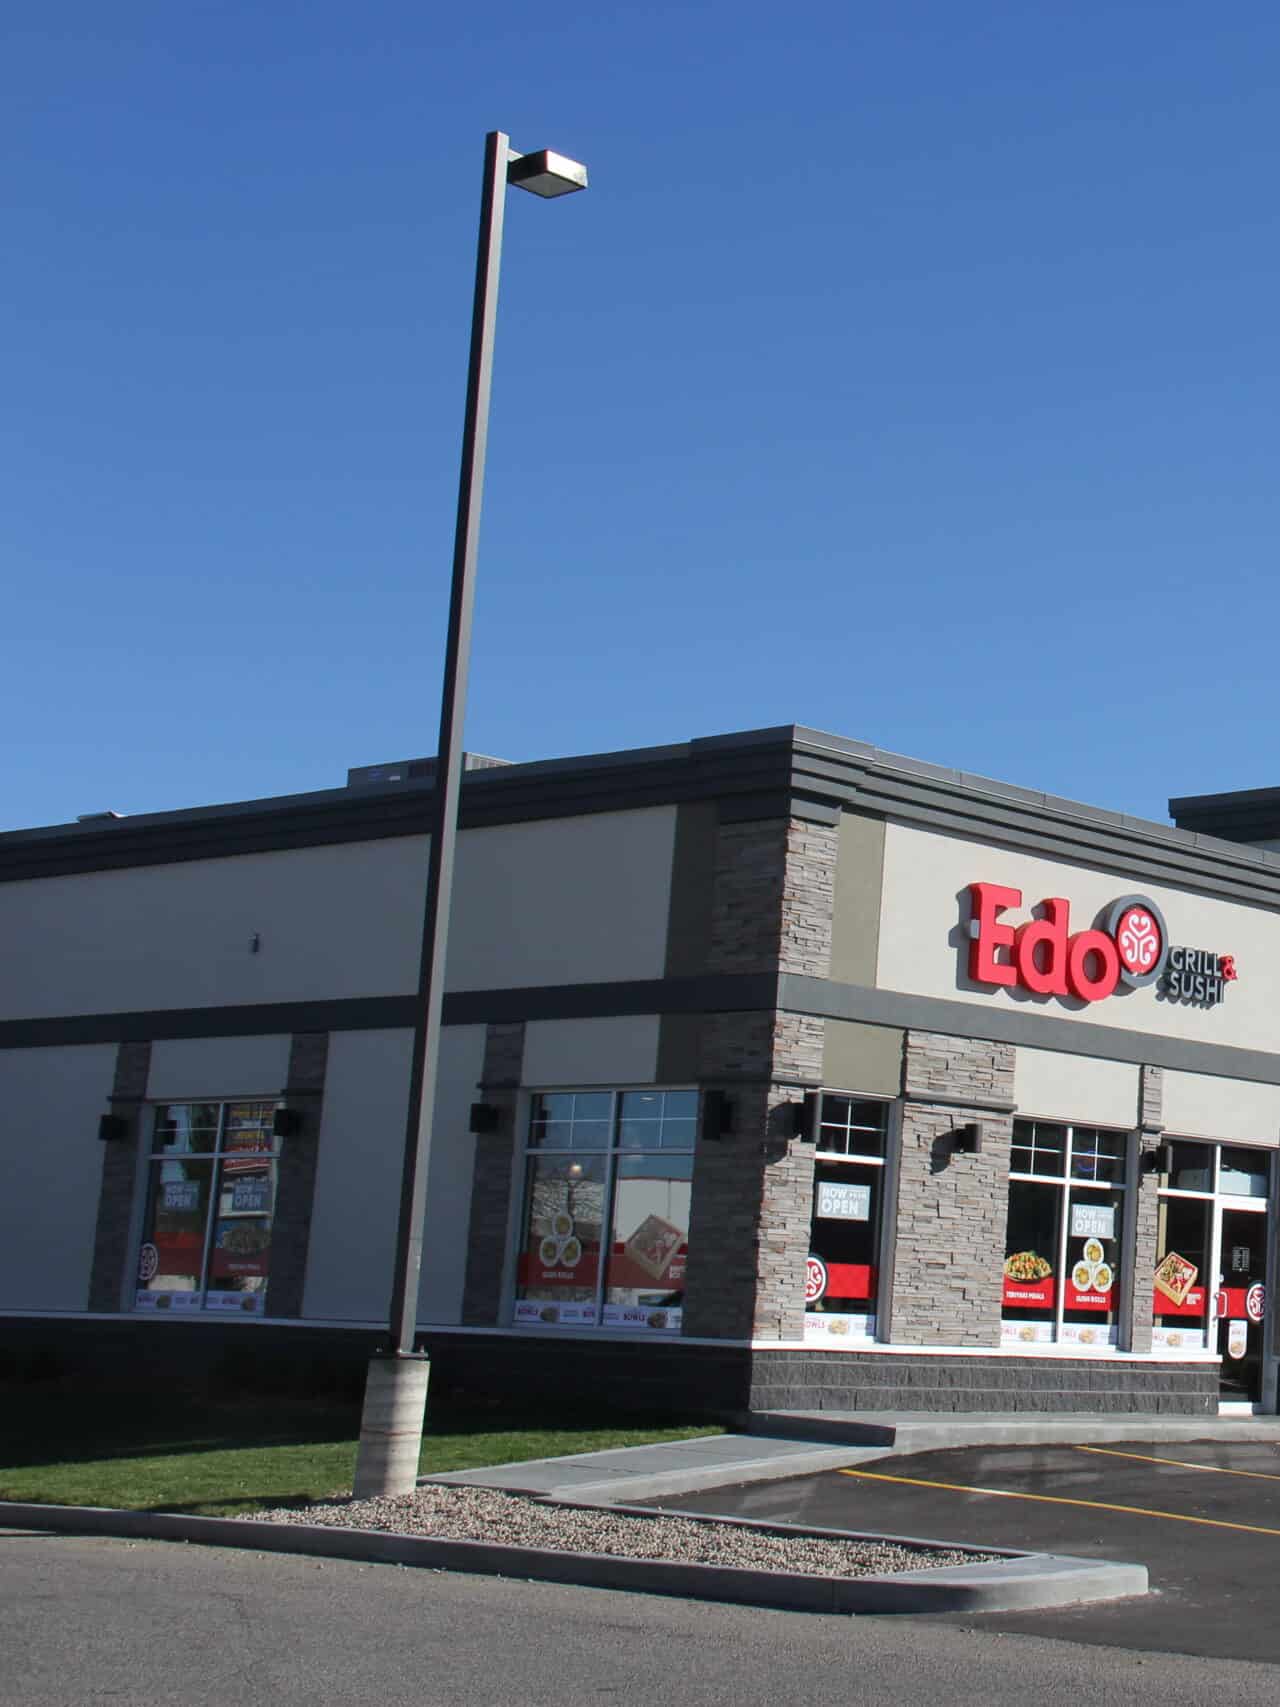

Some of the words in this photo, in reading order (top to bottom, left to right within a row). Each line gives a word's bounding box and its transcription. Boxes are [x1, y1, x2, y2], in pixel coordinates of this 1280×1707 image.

[969, 882, 1120, 1002] Edo
[1170, 946, 1222, 977] GRILL
[1169, 971, 1225, 1003] SUSHI
[235, 1193, 262, 1208] OPEN
[822, 1199, 858, 1215] OPEN
[1075, 1220, 1106, 1233] OPEN
